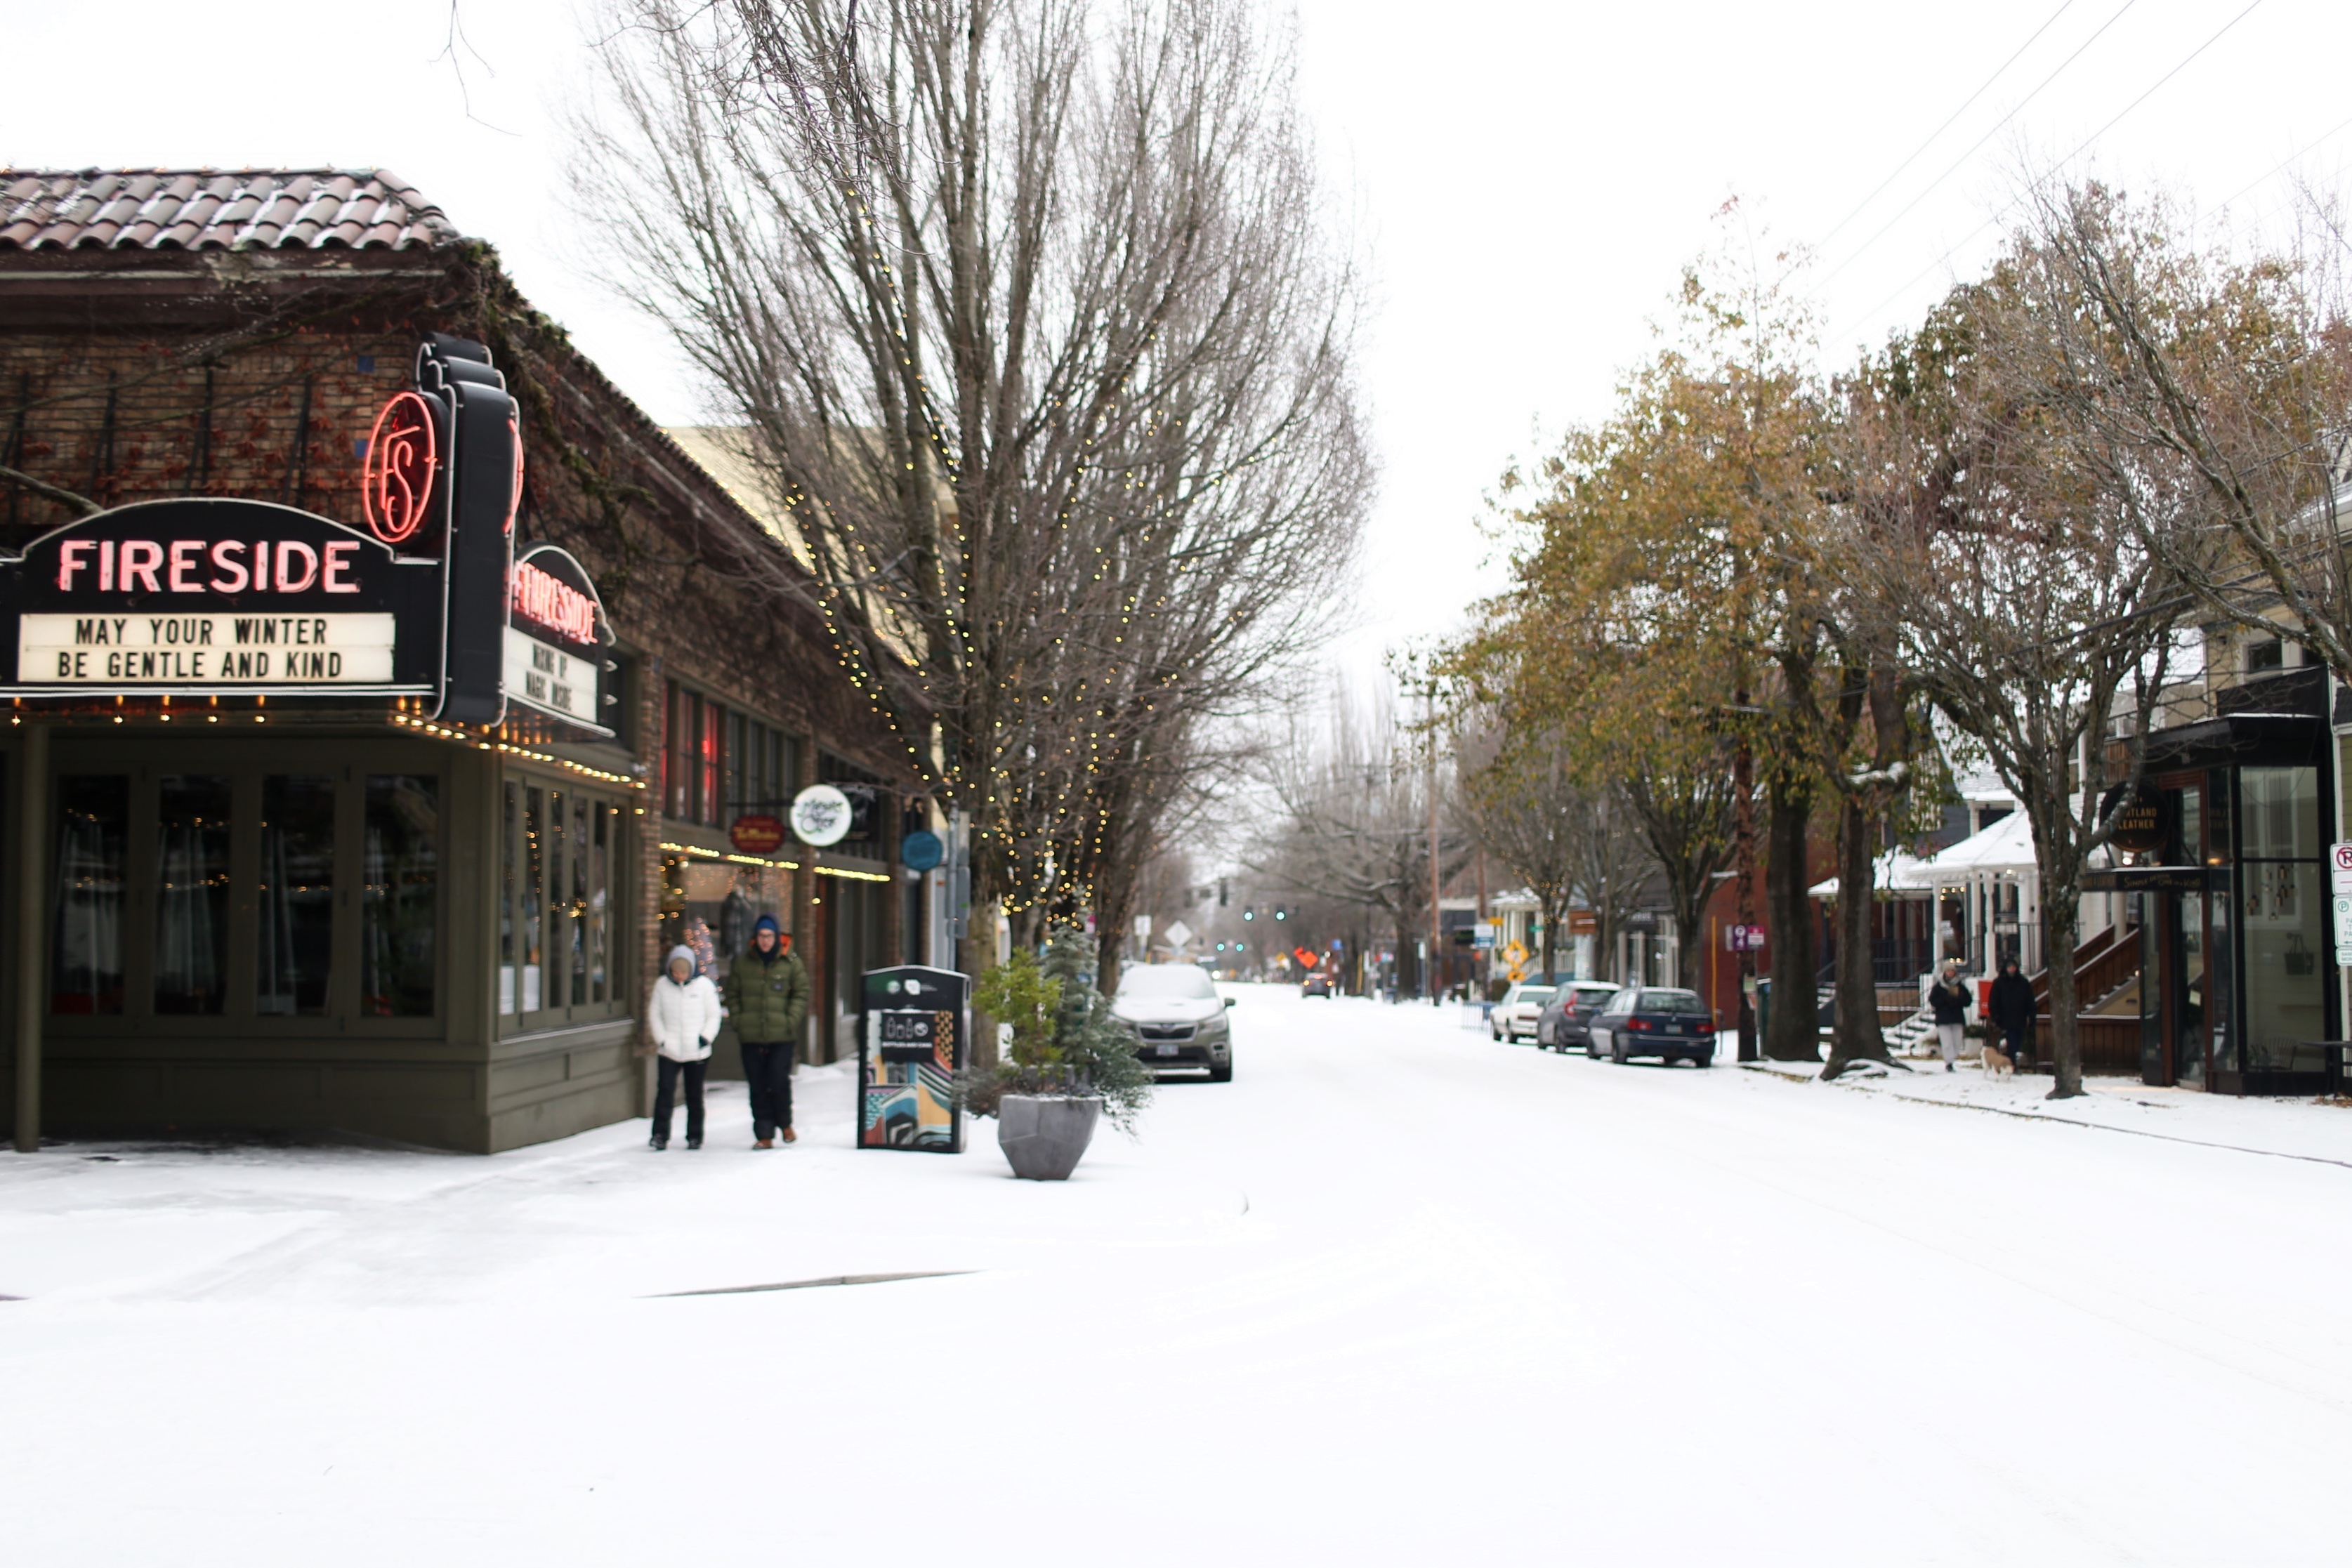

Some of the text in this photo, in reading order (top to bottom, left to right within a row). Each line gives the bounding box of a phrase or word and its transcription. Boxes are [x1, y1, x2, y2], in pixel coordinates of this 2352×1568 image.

[60, 540, 360, 593] FIRESIDE
[513, 560, 597, 644] FIRESIDE
[75, 619, 327, 645] MAY YOUR WINTER
[58, 652, 342, 678] BE GENTLE AND KIND
